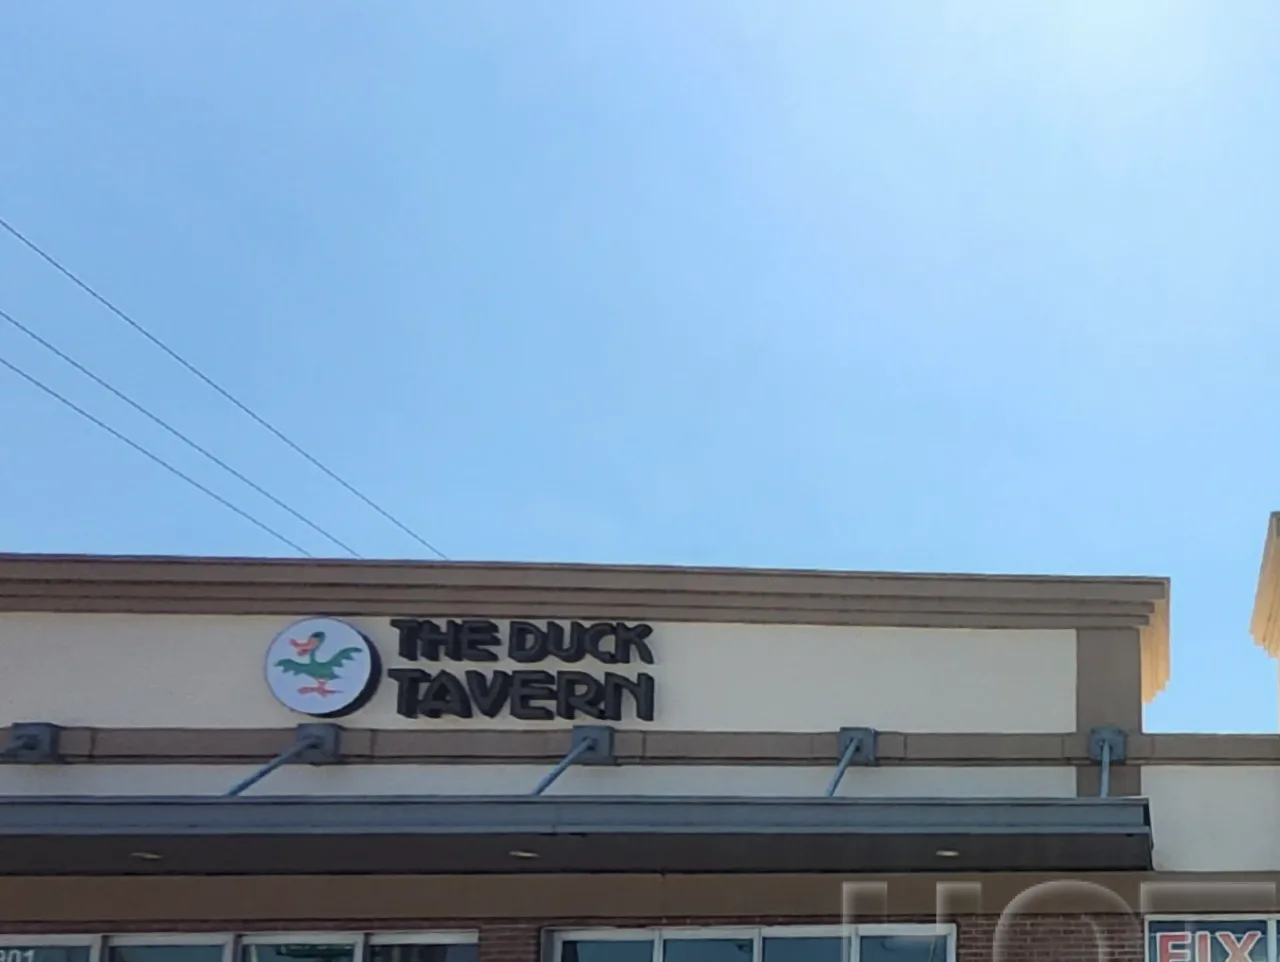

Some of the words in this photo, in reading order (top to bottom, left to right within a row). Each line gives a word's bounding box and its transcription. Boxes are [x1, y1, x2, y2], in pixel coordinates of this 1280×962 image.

[390, 618, 501, 662] THE
[507, 620, 656, 664] DUCK
[387, 667, 656, 721] TAVERN
